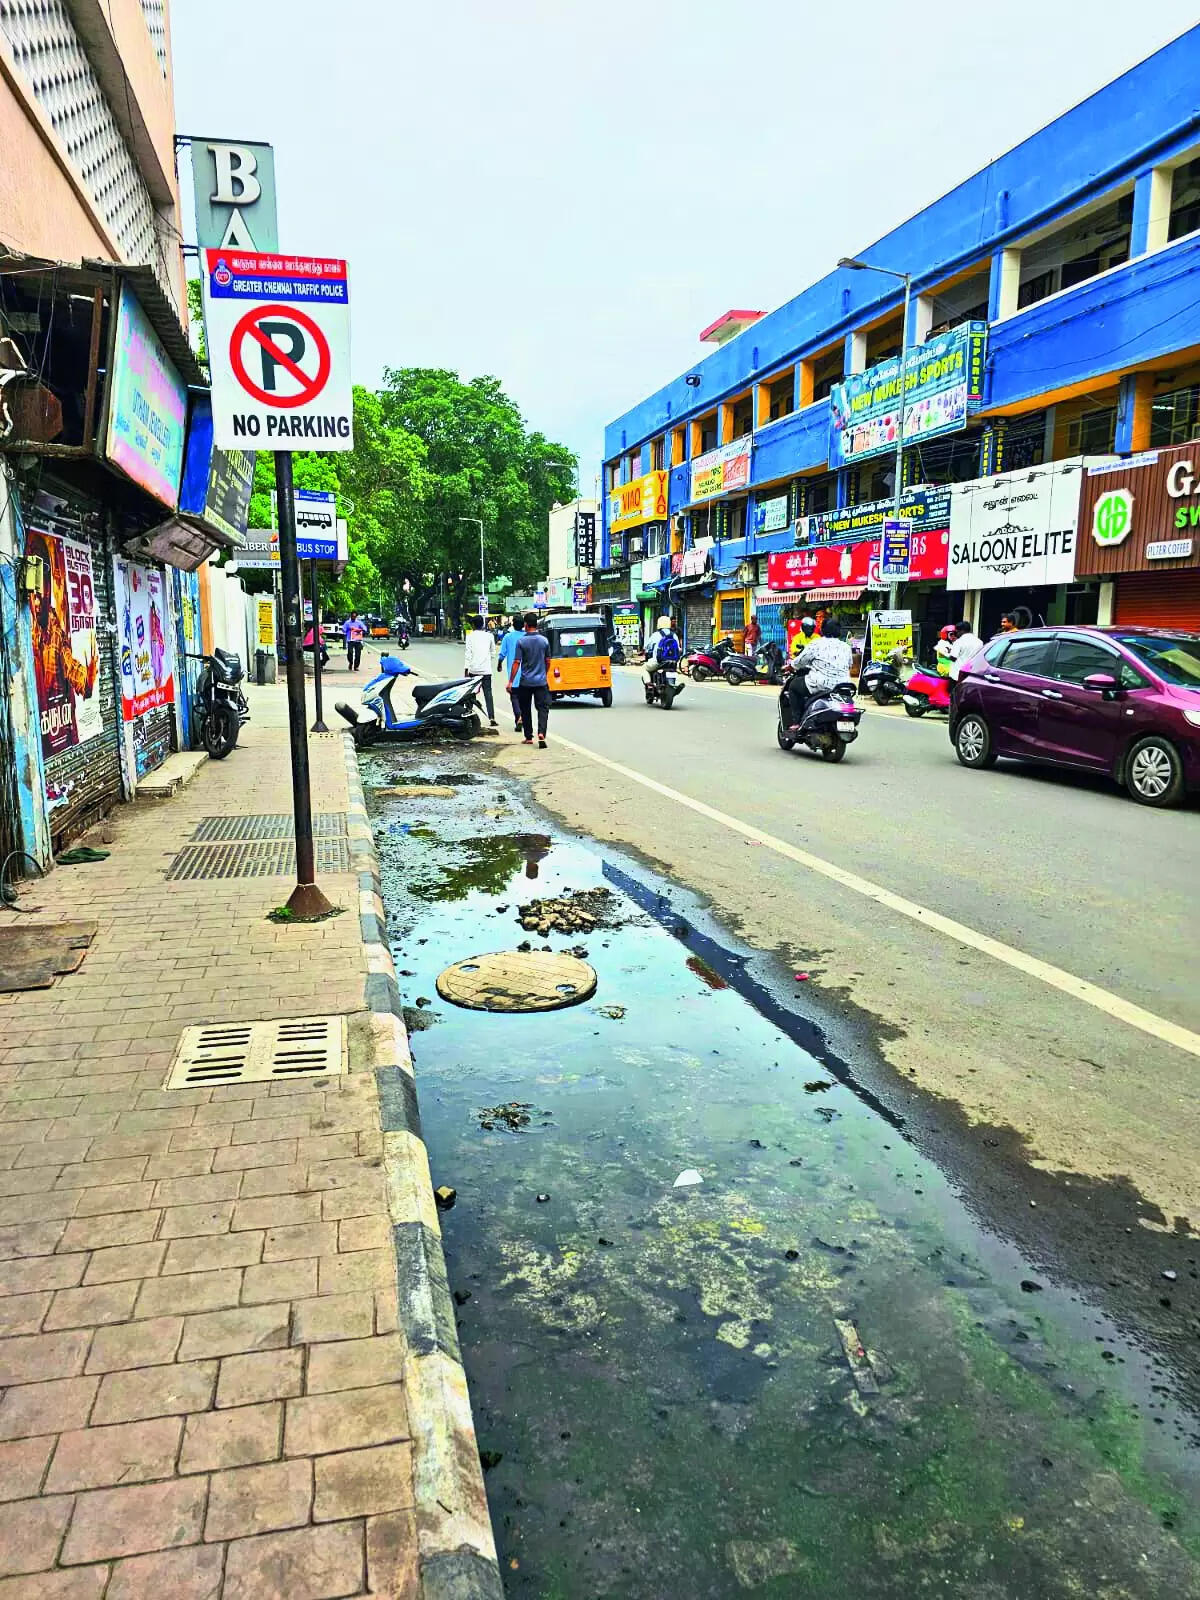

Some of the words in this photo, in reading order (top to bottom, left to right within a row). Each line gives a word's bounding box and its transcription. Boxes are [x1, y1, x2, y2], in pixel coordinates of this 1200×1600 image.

[232, 280, 262, 293] GREATER
[263, 282, 292, 294] CHENNAI
[293, 284, 320, 296] TRAFFIC
[320, 285, 344, 297] POLICE
[971, 337, 982, 395] SPORTS
[851, 391, 873, 413] NEW
[874, 373, 918, 403] MUKESH
[919, 350, 964, 385] SPORTS
[233, 414, 261, 437] NO
[267, 415, 350, 439] PARKING
[1167, 459, 1200, 498] G
[983, 496, 1008, 510] சலூன்
[1010, 493, 1038, 504] எலைட்
[833, 520, 850, 531] NEW
[852, 512, 884, 528] MUKESH
[887, 504, 924, 520] SORTS
[65, 545, 90, 561] BLOCK
[297, 543, 313, 553] BUS
[315, 544, 335, 554] STOP
[952, 537, 1018, 564] SALOON
[1022, 530, 1074, 558] ELITE
[1168, 543, 1190, 555] COFFEE
[66, 560, 91, 573] BUSTER
[68, 571, 94, 615] 30
